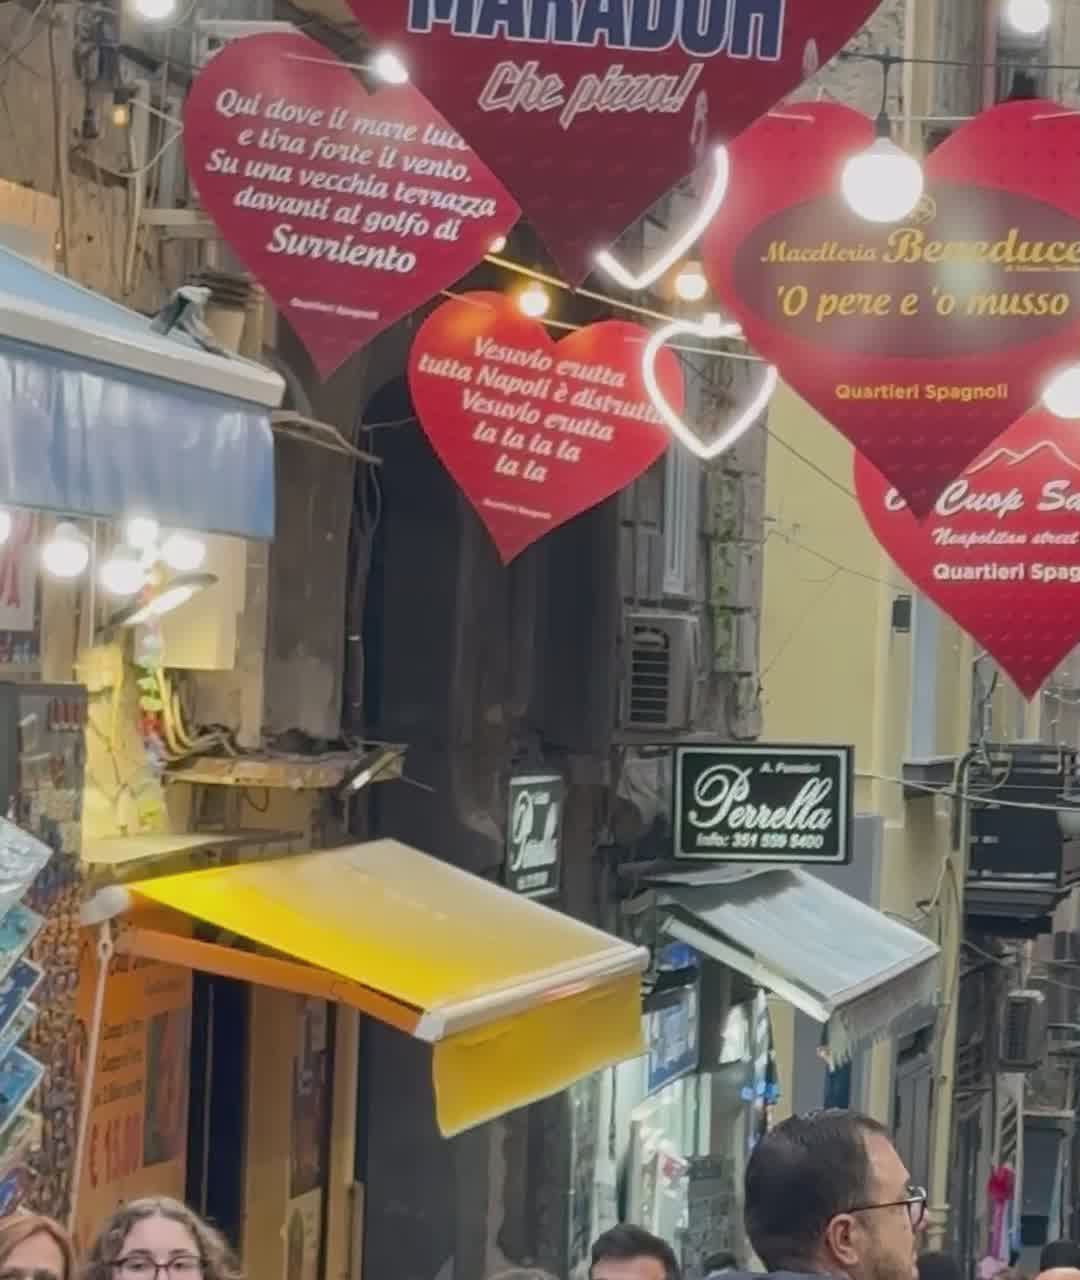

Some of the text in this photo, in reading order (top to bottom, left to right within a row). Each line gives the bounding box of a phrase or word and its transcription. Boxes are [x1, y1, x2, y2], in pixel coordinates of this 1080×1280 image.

[215, 88, 259, 118] Qui
[265, 99, 322, 127] dove
[328, 106, 346, 130] il
[352, 117, 417, 144] mare
[478, 61, 704, 130] Che pizza!
[238, 127, 472, 183] e tira forte il vento.
[206, 148, 497, 220] Su una vecchia terrazza
[234, 186, 461, 242] davanti al golfo di
[266, 223, 416, 273] Surriento
[760, 239, 878, 263] Macelleria
[816, 292, 891, 323] pere
[901, 292, 918, 316] e
[967, 292, 1070, 316] musso
[418, 353, 473, 382] tutta
[476, 364, 553, 400] Napoli
[474, 336, 626, 388] Vesuvio erutta
[461, 389, 614, 441] Vesuvio erutta
[835, 383, 1008, 403] Quartieri Spagnoli
[935, 479, 1025, 518] Cuop
[933, 563, 1025, 581] Quartieri
[688, 763, 833, 830] Perrella
